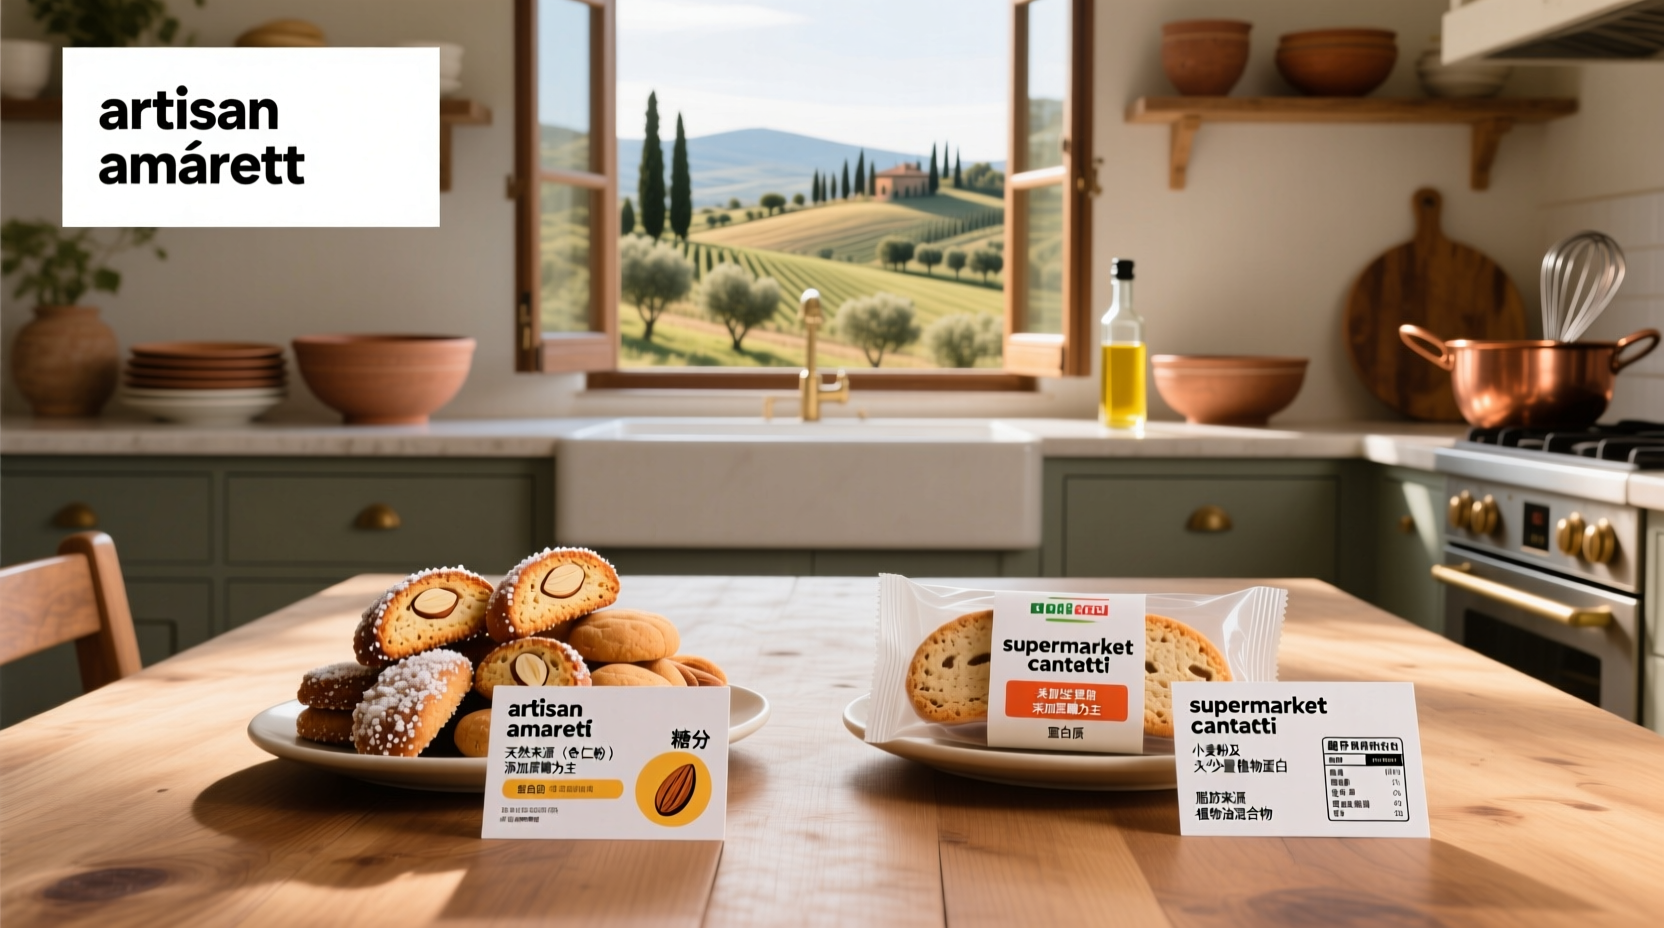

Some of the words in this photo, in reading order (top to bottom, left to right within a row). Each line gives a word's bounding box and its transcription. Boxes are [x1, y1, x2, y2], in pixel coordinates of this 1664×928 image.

[1003, 637, 1134, 656] supermarket
[508, 697, 583, 717] artisan
[1190, 696, 1328, 718] supermarket
